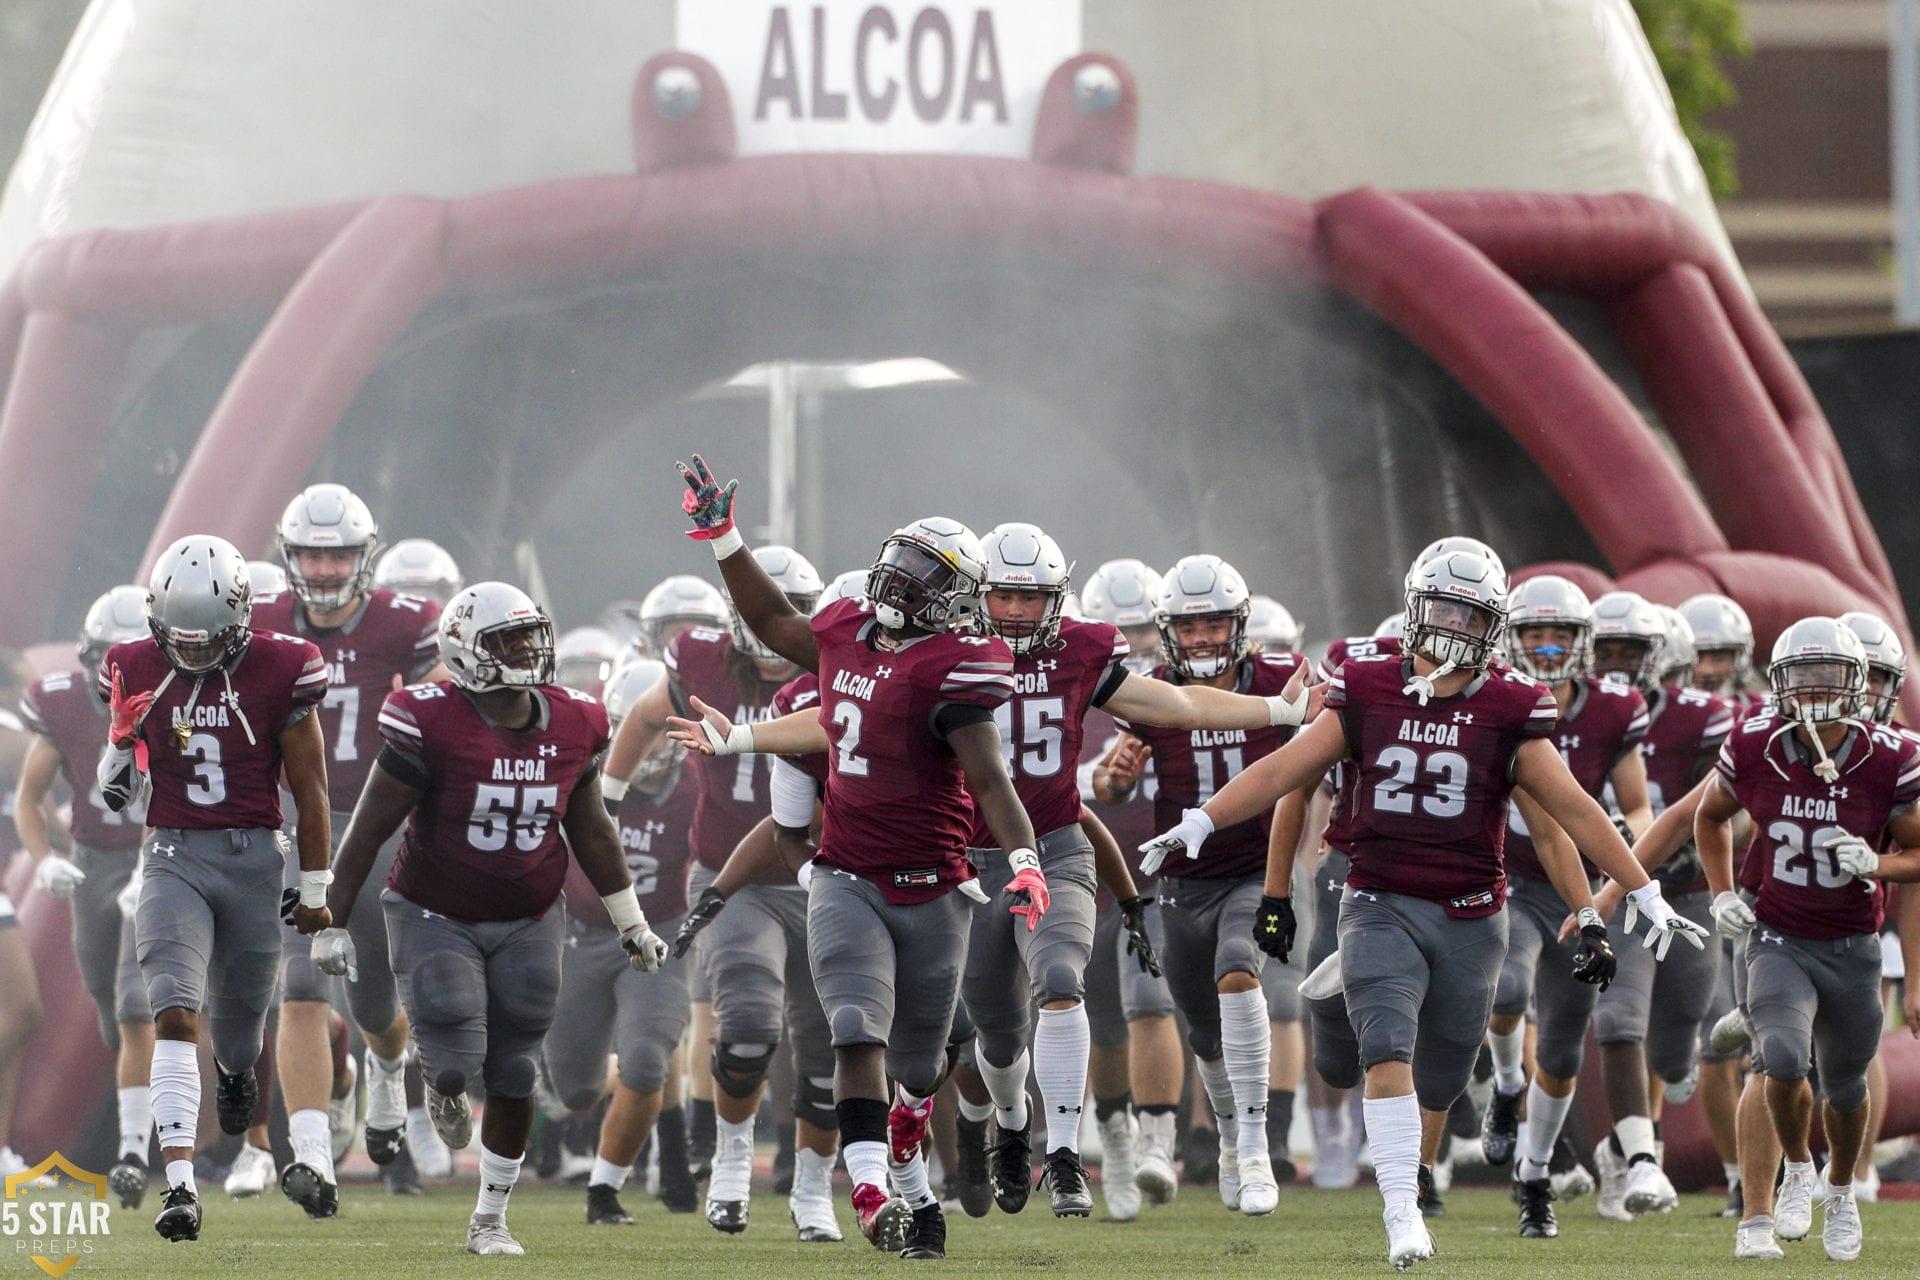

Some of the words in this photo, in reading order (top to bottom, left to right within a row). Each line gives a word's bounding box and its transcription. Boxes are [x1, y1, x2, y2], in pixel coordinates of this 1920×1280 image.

[754, 5, 1009, 124] ALCOA
[1005, 574, 1033, 583] Riddell
[1450, 585, 1477, 597] Riddell
[832, 669, 877, 702] ALCOA
[1013, 672, 1049, 694] COA
[831, 698, 870, 778] 2
[1398, 718, 1459, 747] ALCOA
[180, 731, 228, 806] 3
[492, 758, 546, 782] ALCOA
[1193, 747, 1245, 807] 11
[1374, 744, 1470, 819] 23
[466, 782, 559, 852] 55
[1781, 794, 1838, 822] ALCOA
[620, 826, 652, 852] COA
[1766, 818, 1855, 889] 20
